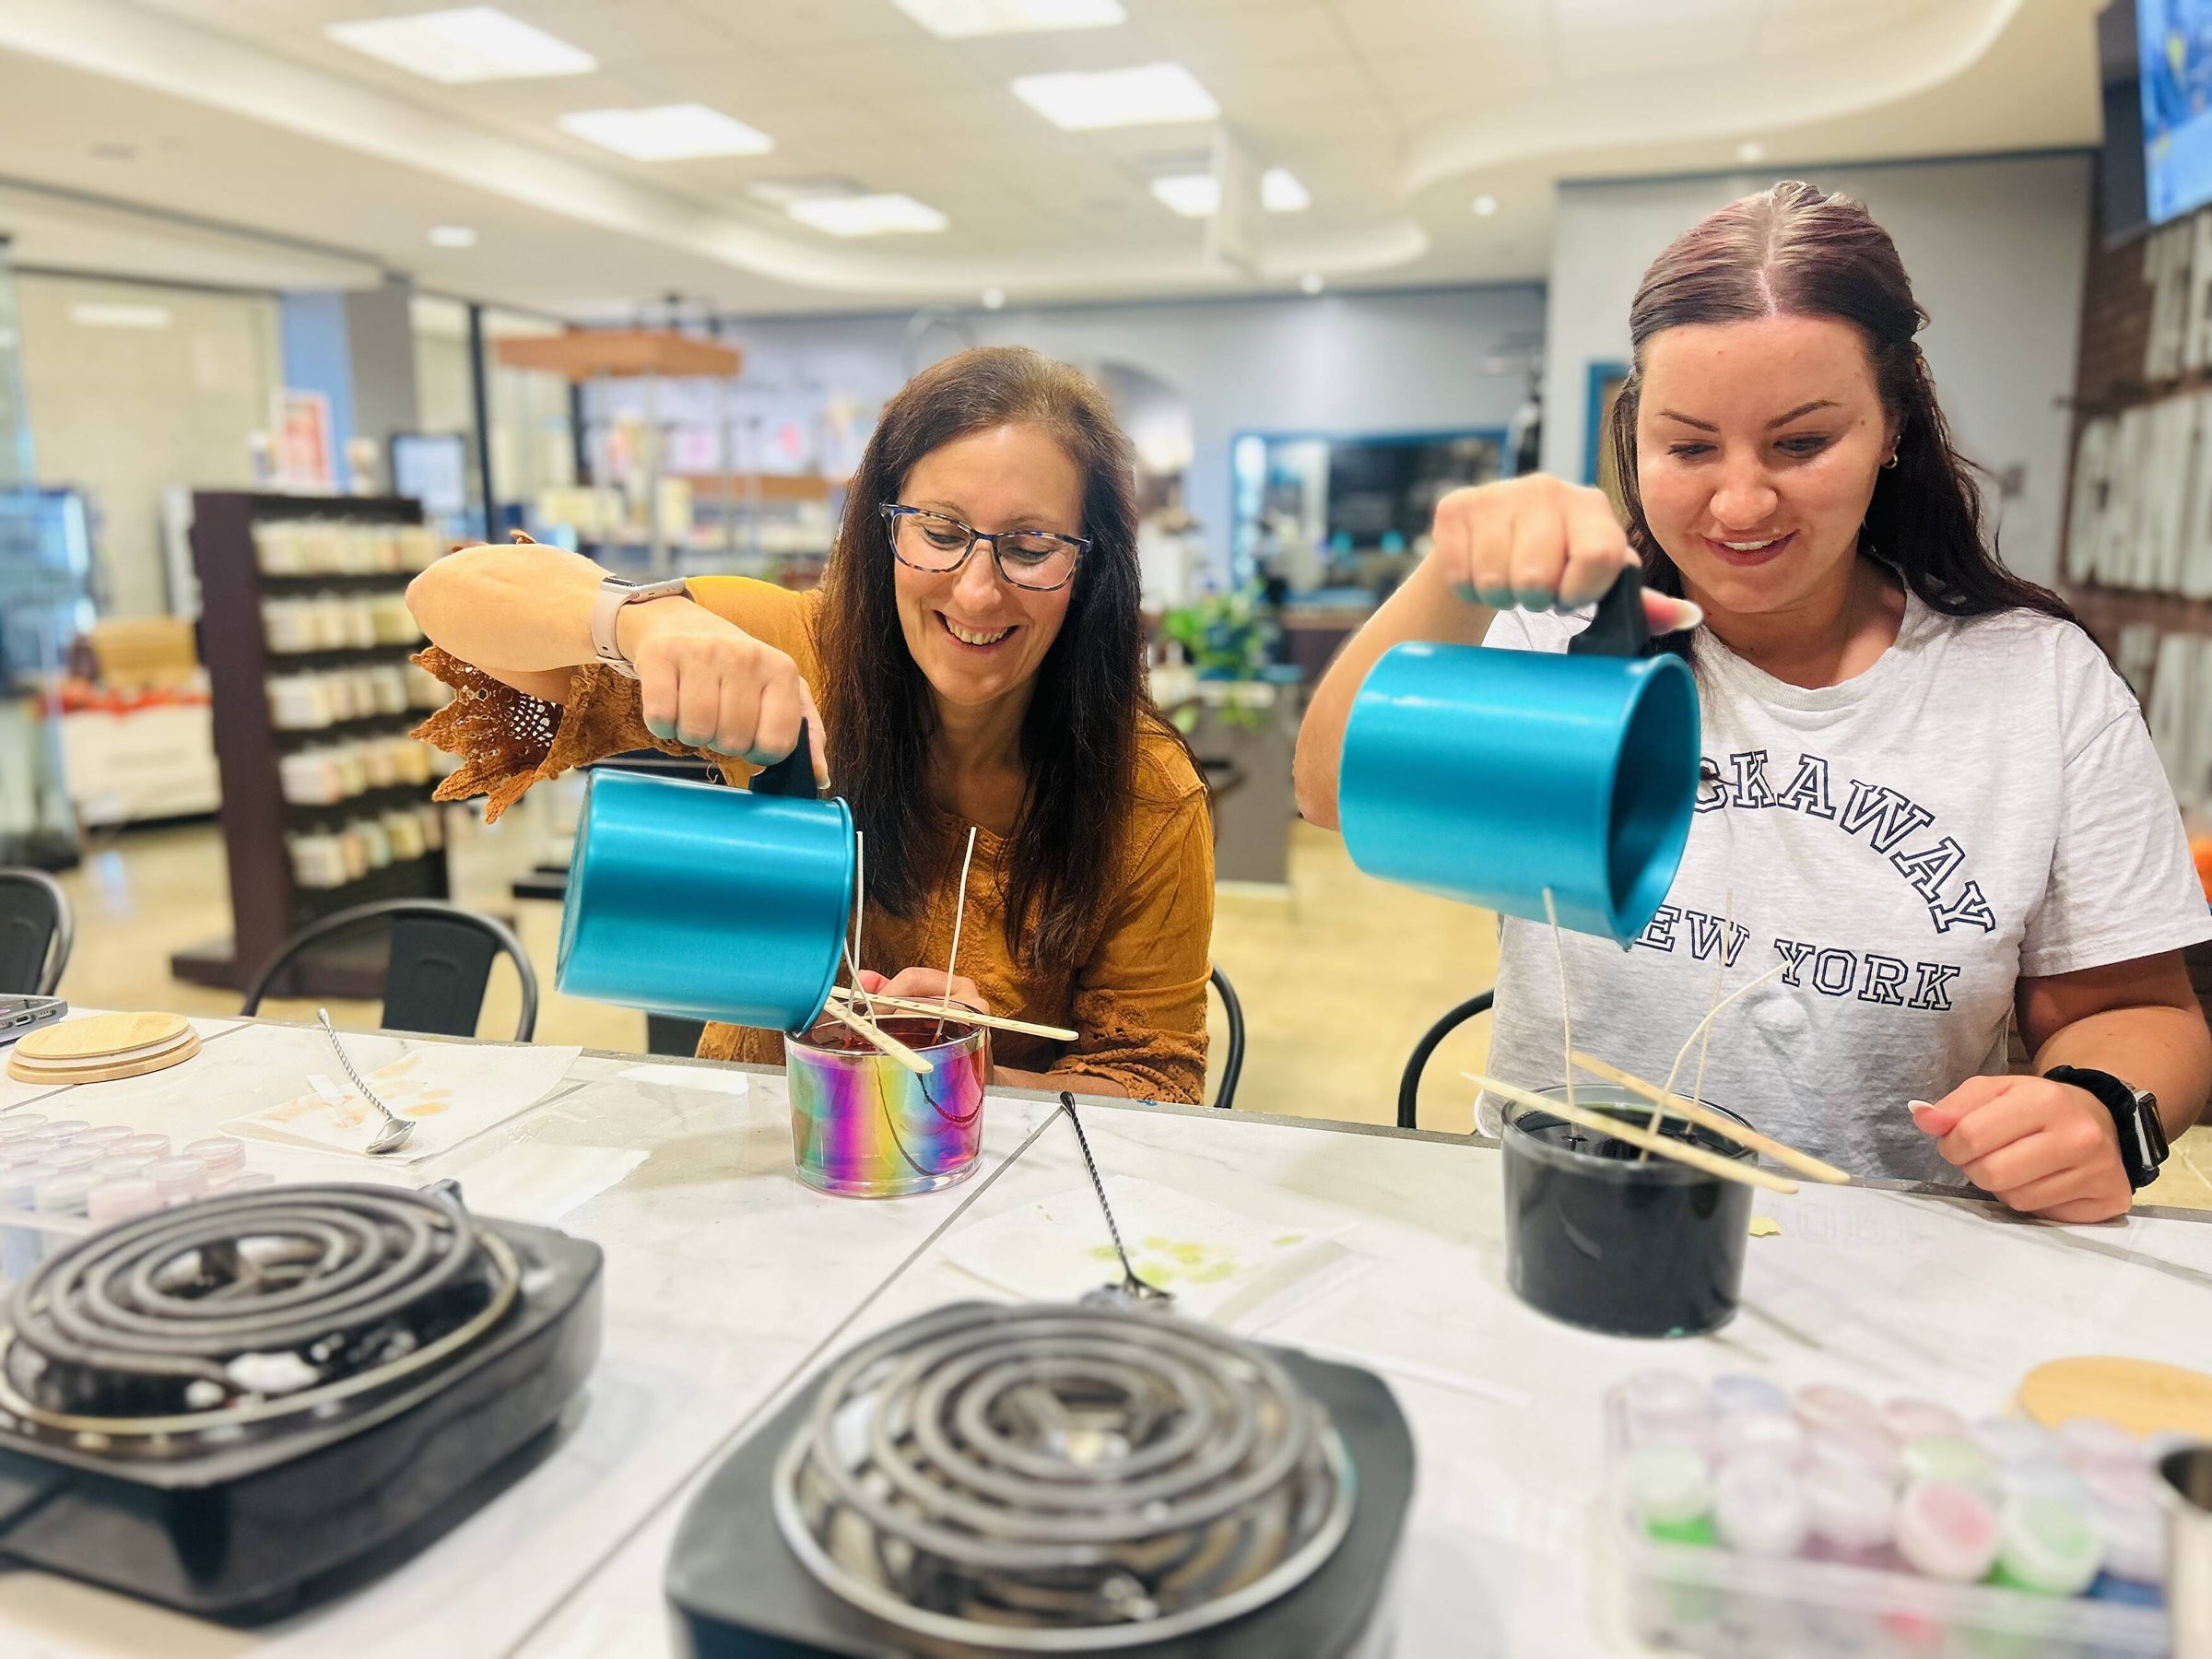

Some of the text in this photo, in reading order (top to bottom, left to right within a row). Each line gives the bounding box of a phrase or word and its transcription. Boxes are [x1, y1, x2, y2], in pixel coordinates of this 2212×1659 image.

[1694, 749, 1996, 935] CKAWAY
[1634, 904, 1961, 1011] EW YORK
